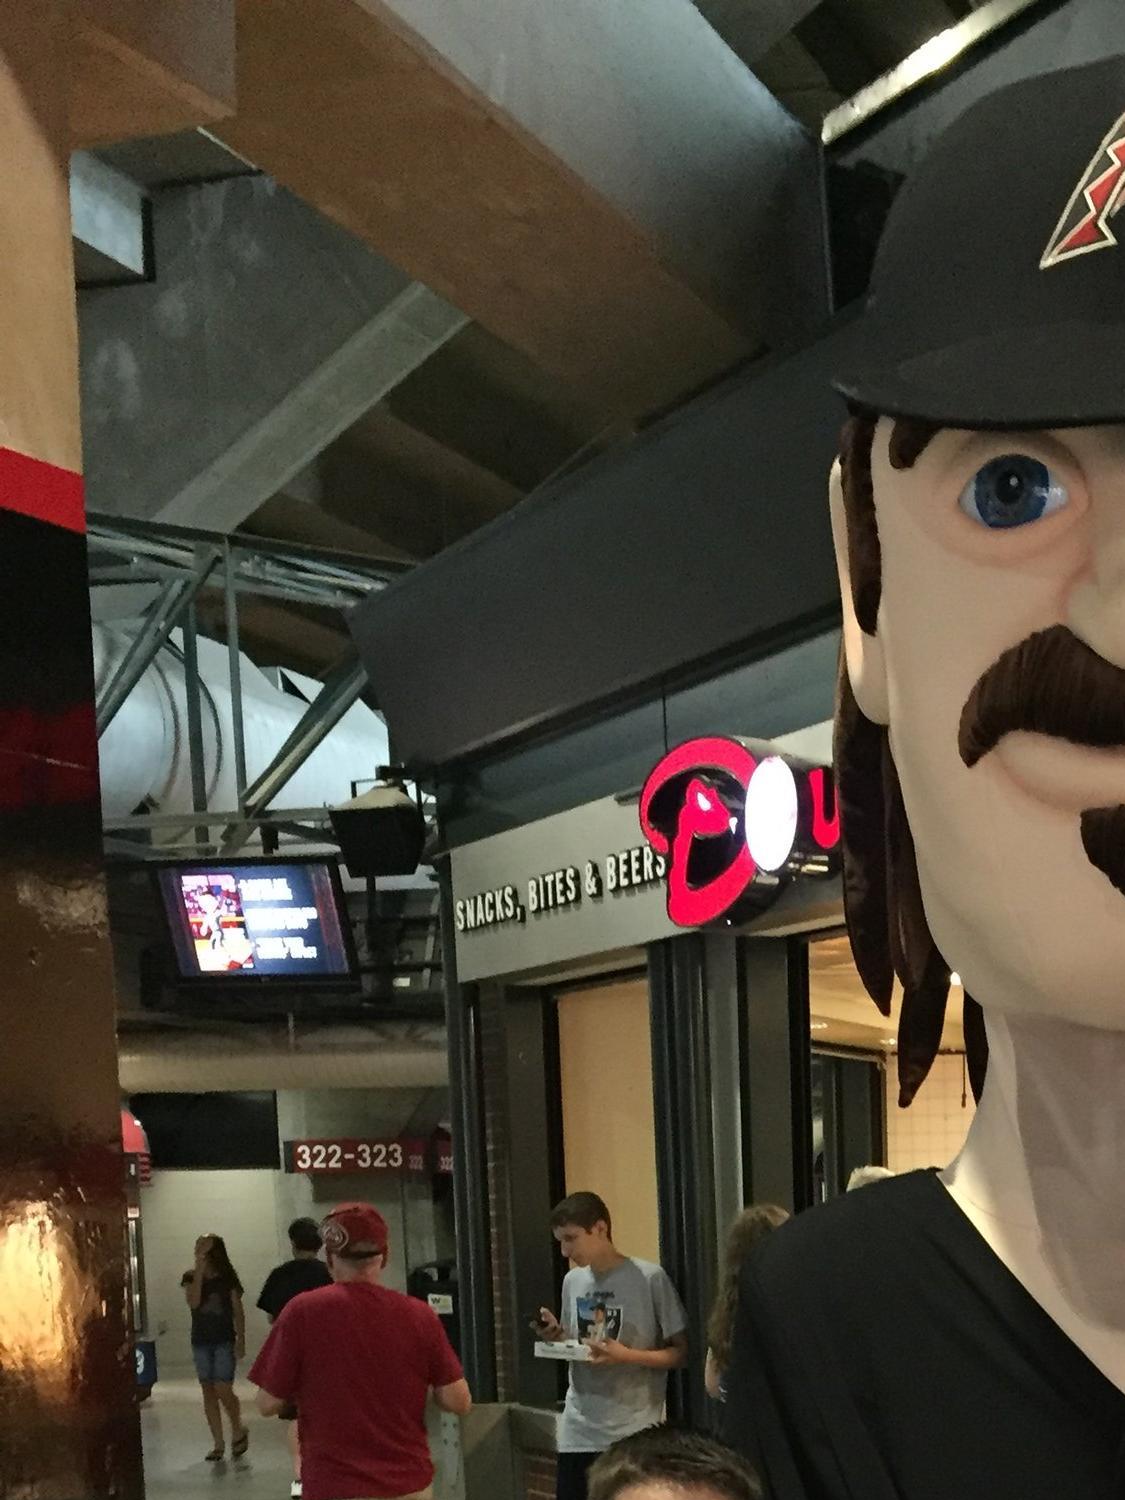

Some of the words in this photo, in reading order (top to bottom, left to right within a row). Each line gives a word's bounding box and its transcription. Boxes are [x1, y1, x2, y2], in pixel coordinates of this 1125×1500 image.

[455, 885, 521, 931] SNACKS,
[528, 867, 577, 912] BITES
[584, 861, 598, 897] &
[606, 845, 667, 891] BEERS
[297, 1142, 403, 1169] 322-323
